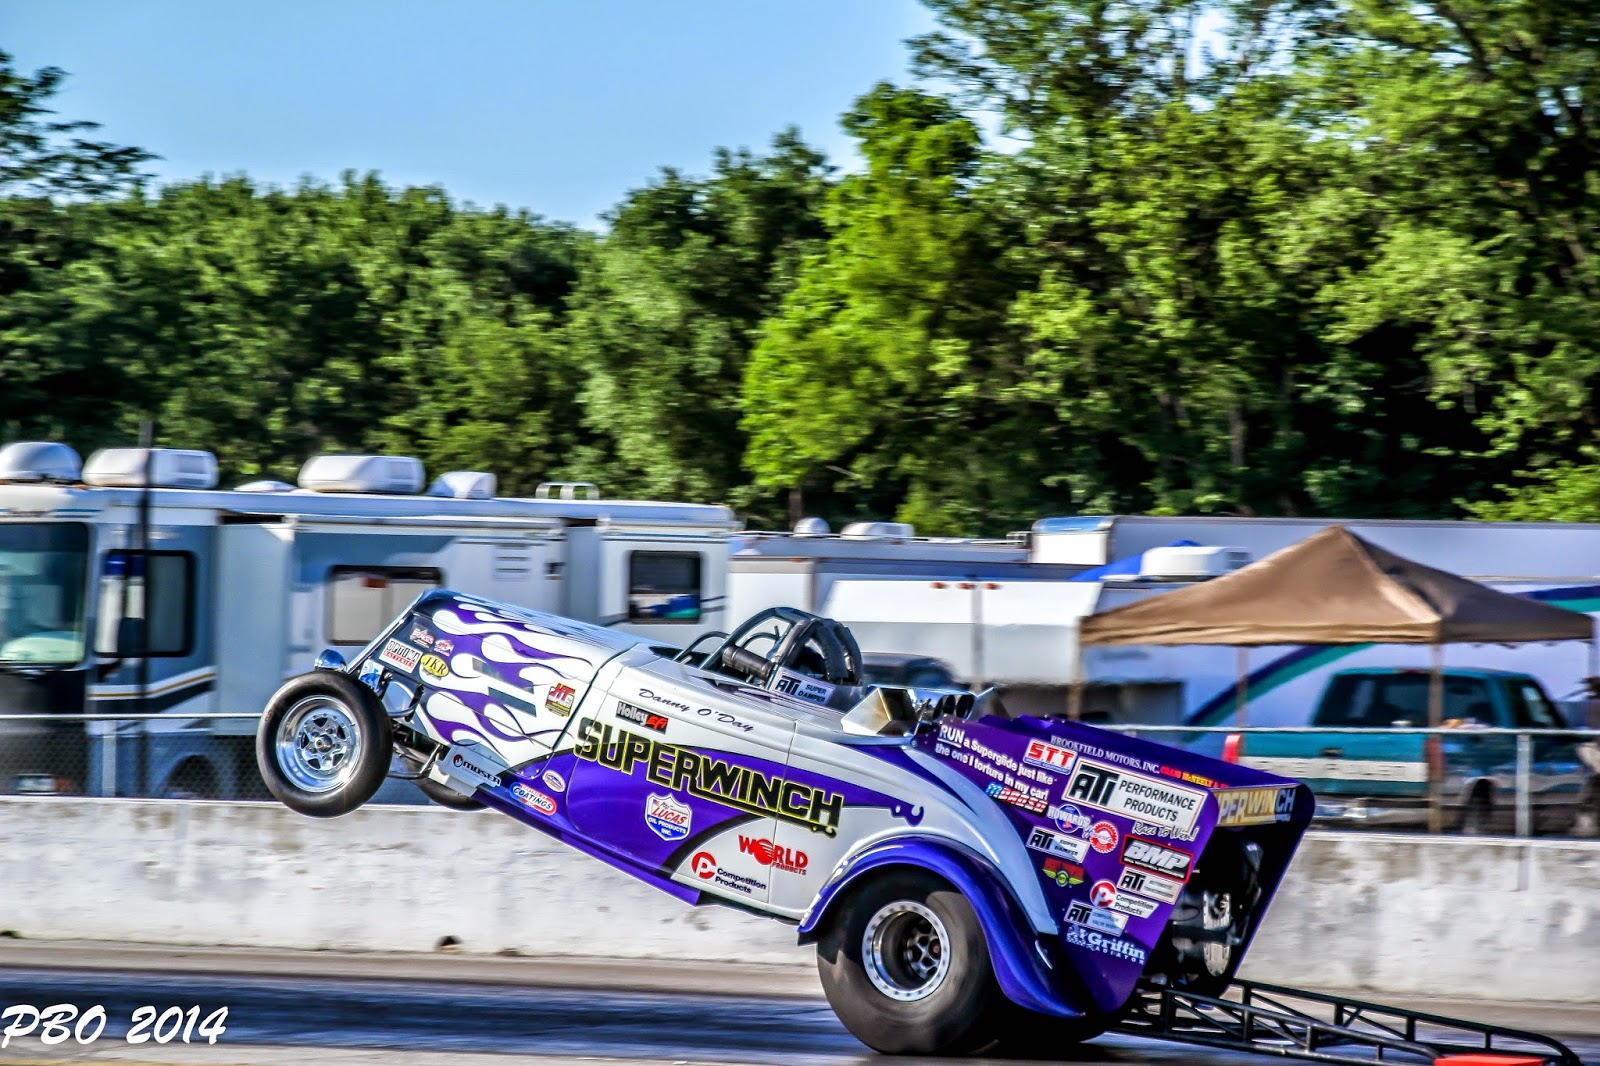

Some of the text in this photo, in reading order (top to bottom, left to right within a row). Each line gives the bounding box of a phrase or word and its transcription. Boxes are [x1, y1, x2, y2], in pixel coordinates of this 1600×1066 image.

[422, 656, 447, 675] JKR
[775, 675, 802, 695] ATI
[798, 691, 826, 702] DAMPER
[805, 684, 827, 695] SUPER
[616, 701, 647, 727] Holley
[638, 688, 755, 732] Danny O'Day
[939, 724, 1054, 785] RUN a Superglide just like
[1050, 735, 1104, 758] BROOKFIELD
[1142, 760, 1160, 775] INC.
[573, 716, 844, 834] SUPERWINCH
[934, 743, 950, 757] the
[951, 750, 969, 764] one
[974, 757, 1004, 782] torture
[1004, 772, 1014, 787] in
[1014, 780, 1030, 795] my
[1029, 787, 1049, 801] car!
[1068, 763, 1121, 807] ATI
[1118, 779, 1196, 811] PERFORMANCE
[513, 787, 552, 810] COATINGS
[1123, 797, 1180, 822] PRODUCTS
[1214, 788, 1297, 824] PERWINCH
[647, 816, 687, 835] OIL PRODUCTS
[651, 807, 688, 825] LUCAS
[1047, 805, 1091, 829] HOWARDS
[1030, 829, 1056, 850] ATI
[738, 834, 808, 869] WORLD
[1124, 840, 1190, 870] BMP
[716, 867, 767, 890] Competition
[771, 862, 807, 876] PRODUCTS
[1121, 870, 1147, 891] ATI
[715, 876, 752, 895] Products
[1067, 904, 1093, 924] ATI
[1114, 902, 1143, 916] Products
[1115, 894, 1154, 911] Competition
[1088, 932, 1145, 960] Griffin
